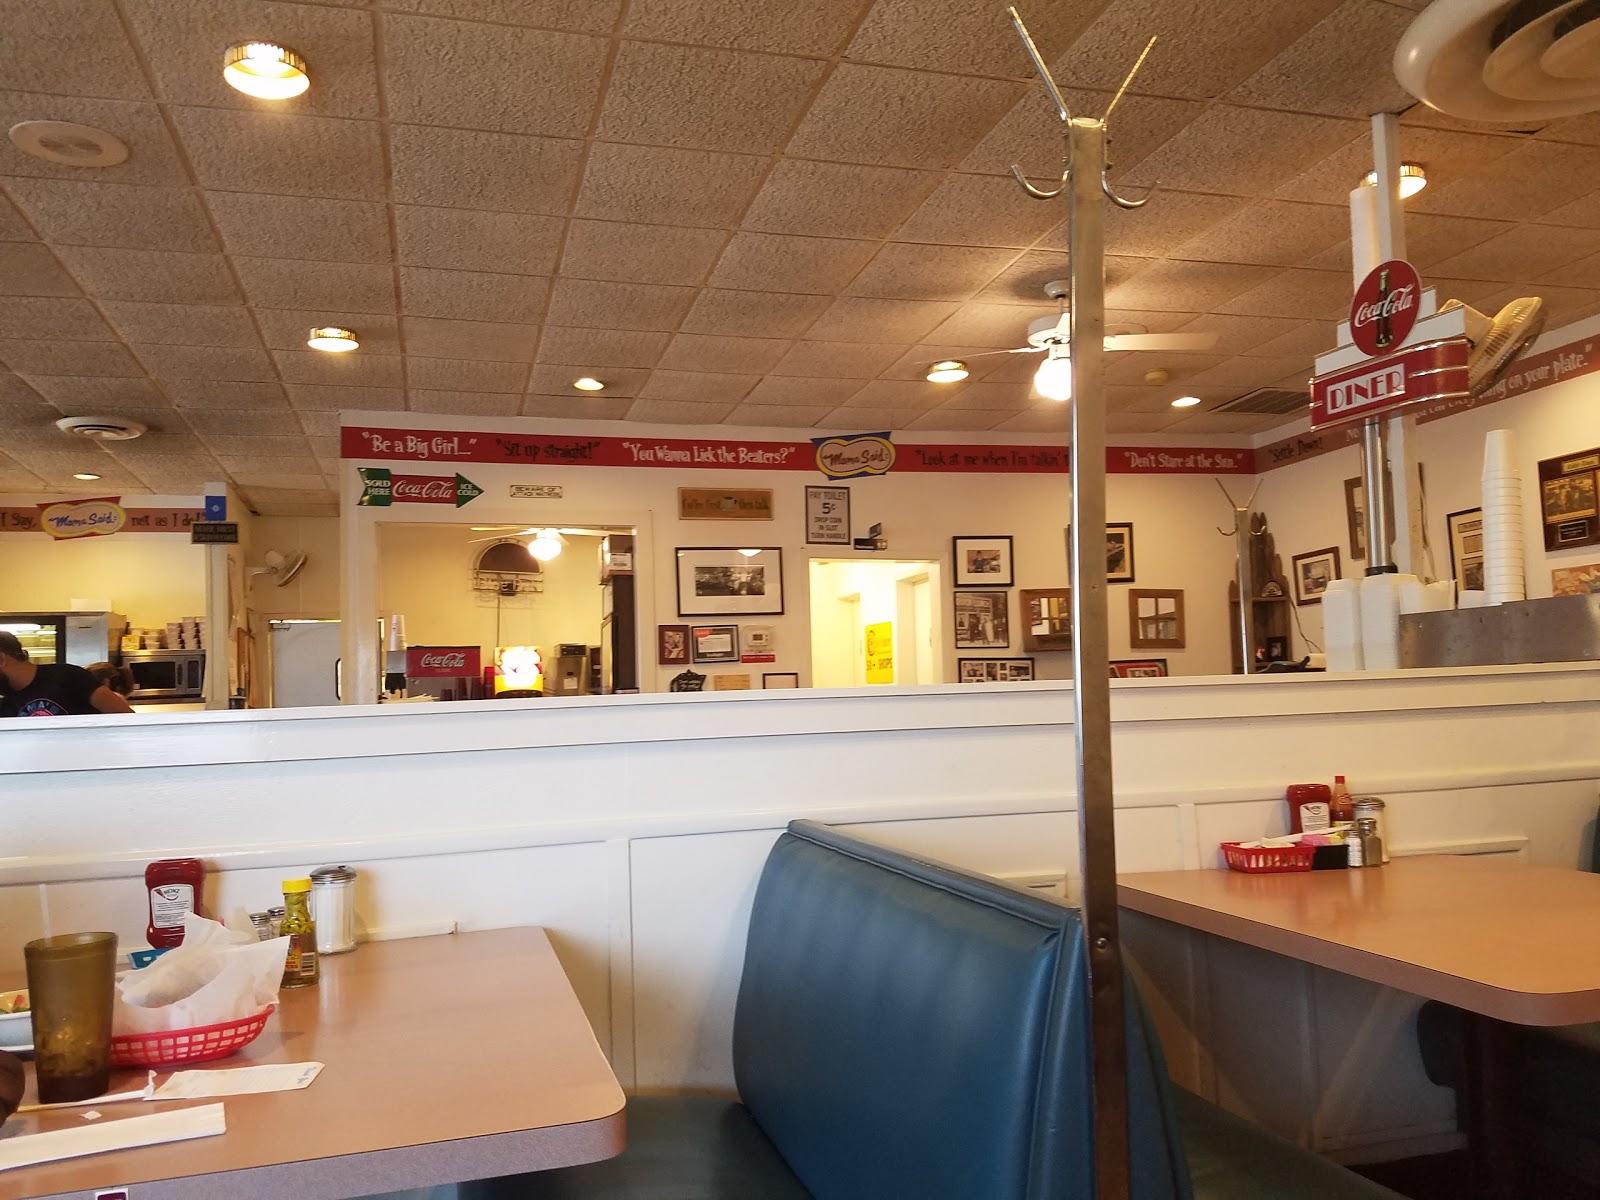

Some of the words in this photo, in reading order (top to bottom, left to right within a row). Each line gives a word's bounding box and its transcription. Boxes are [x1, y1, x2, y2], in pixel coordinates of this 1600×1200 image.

[1355, 283, 1415, 328] Coca-Cola
[1509, 374, 1522, 389] on
[1523, 364, 1551, 390] your
[1330, 368, 1404, 411] DINER
[394, 441, 404, 453] a
[404, 435, 430, 458] Big
[654, 448, 691, 463] Wanna
[692, 448, 714, 463] Lick
[716, 447, 737, 463] the
[949, 452, 960, 466] at
[1157, 452, 1185, 468] Stare
[1184, 454, 1195, 468] at
[1197, 453, 1212, 468] the
[393, 480, 454, 498] Coca-Cola
[809, 491, 821, 499] PAY
[823, 491, 847, 500] TOILET
[48, 514, 87, 528] Mama
[130, 514, 151, 527] not
[154, 516, 168, 527] as
[171, 513, 178, 527] I
[421, 652, 466, 668] Coca-Cola
